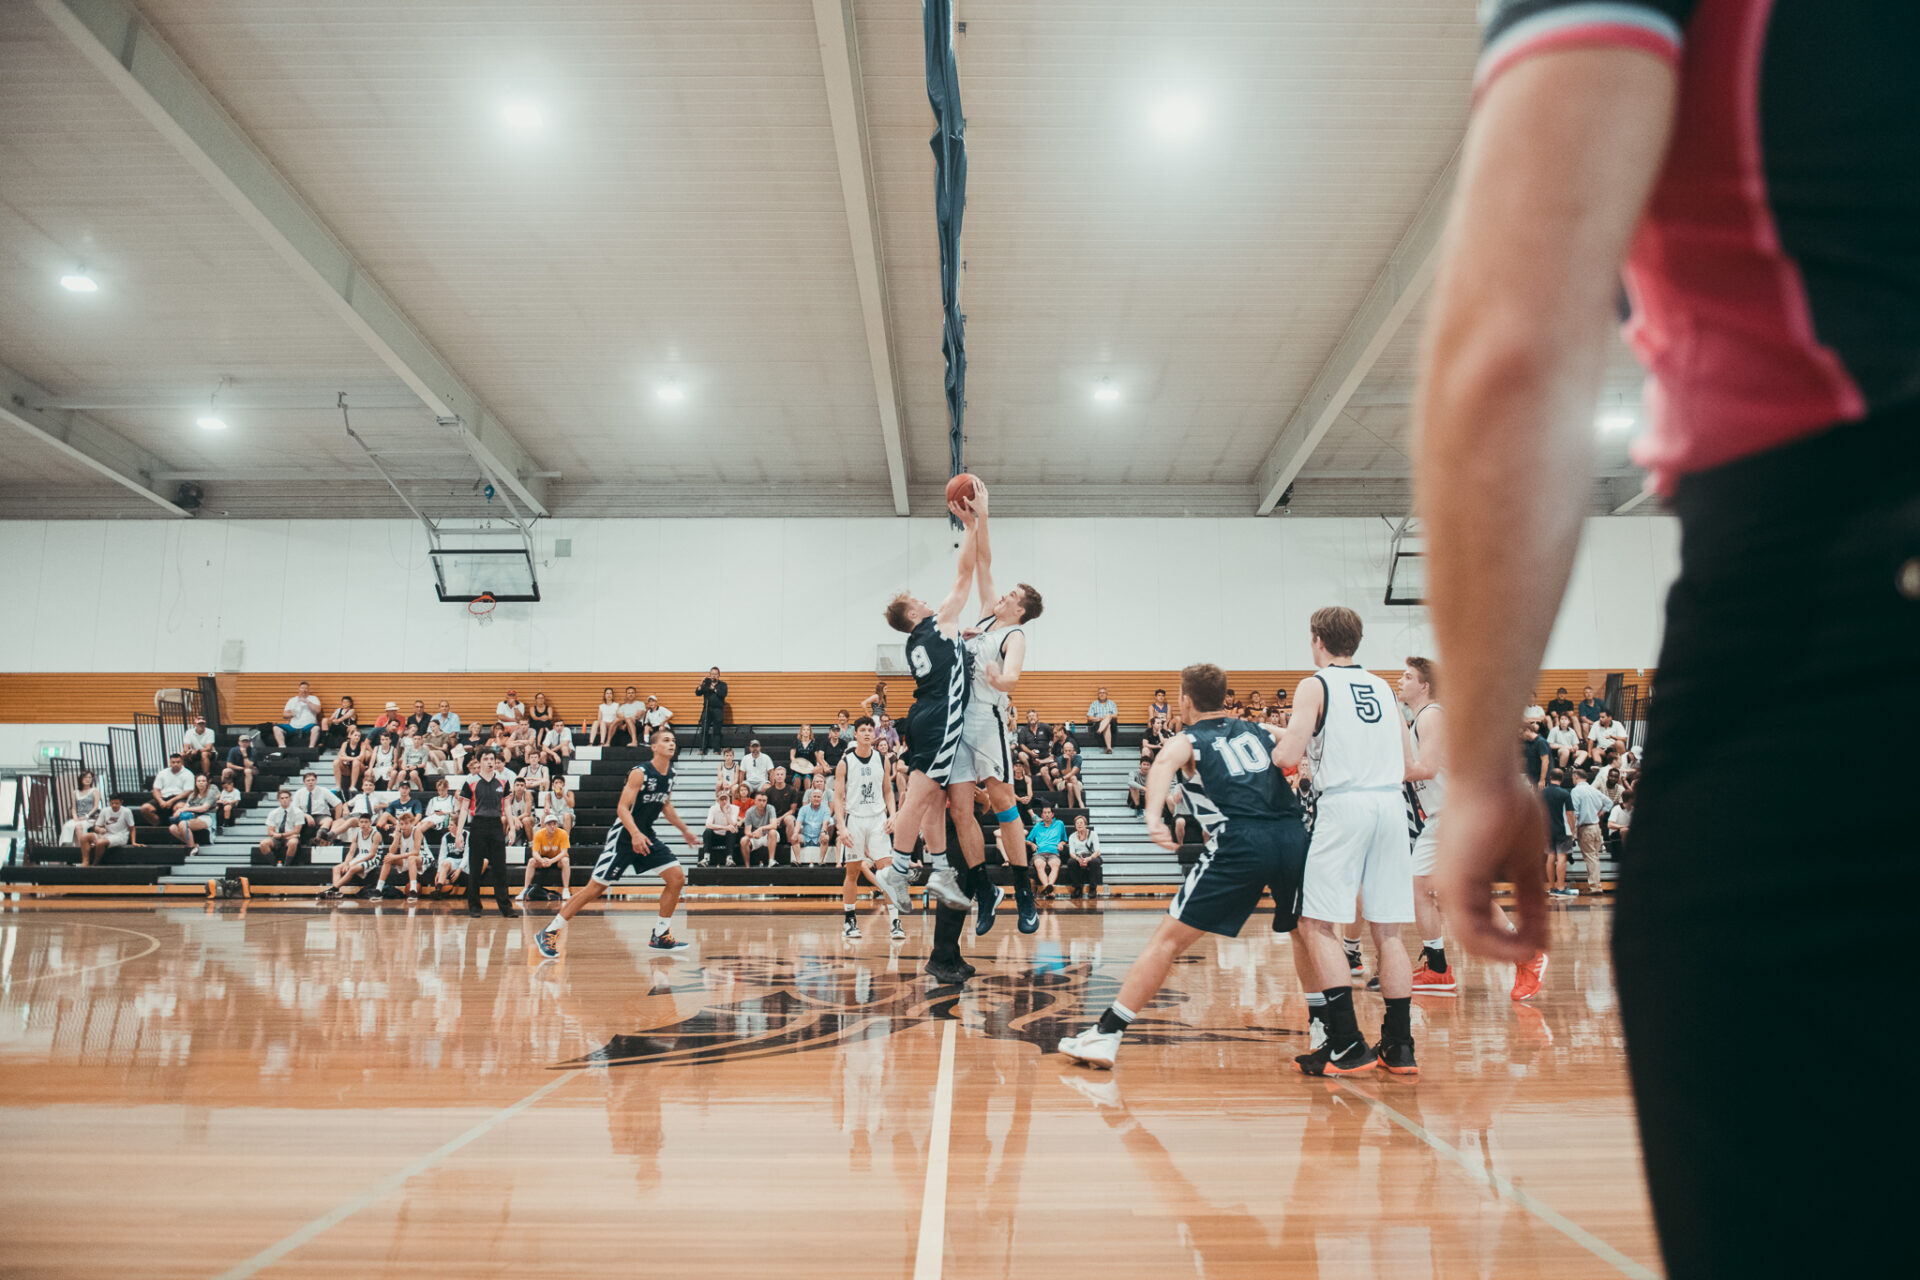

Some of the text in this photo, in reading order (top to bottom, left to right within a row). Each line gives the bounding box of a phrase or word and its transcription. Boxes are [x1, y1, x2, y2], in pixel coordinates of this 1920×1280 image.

[911, 645, 932, 678] 9
[1350, 683, 1382, 723] 5
[1211, 731, 1271, 776] 10
